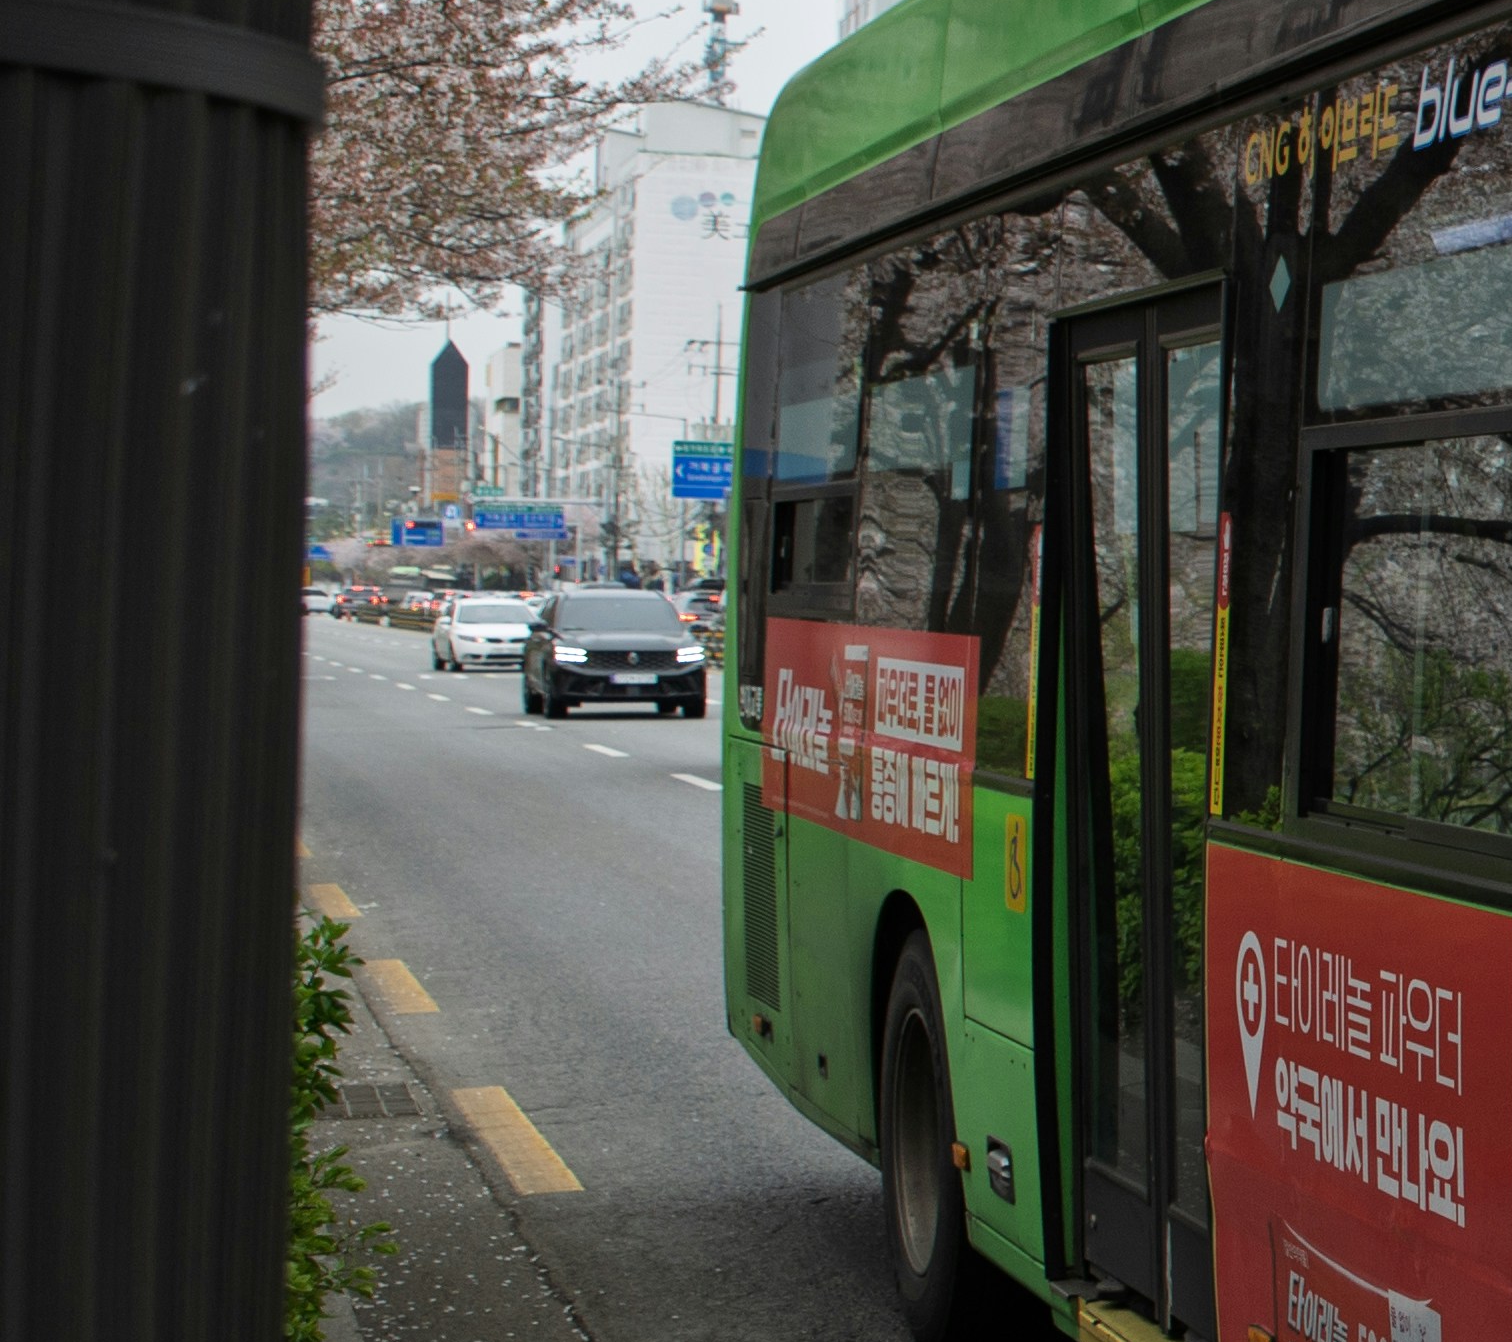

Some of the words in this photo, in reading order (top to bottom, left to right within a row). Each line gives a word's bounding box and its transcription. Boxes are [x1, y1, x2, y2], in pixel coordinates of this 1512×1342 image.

[1243, 122, 1291, 186] CNG
[1295, 83, 1403, 172] 하이브리드
[1272, 935, 1374, 1058] 타이레놀
[1379, 966, 1465, 1099] 파우더
[1272, 1059, 1371, 1183] 약국에서
[1373, 1096, 1468, 1229] 만나요!
